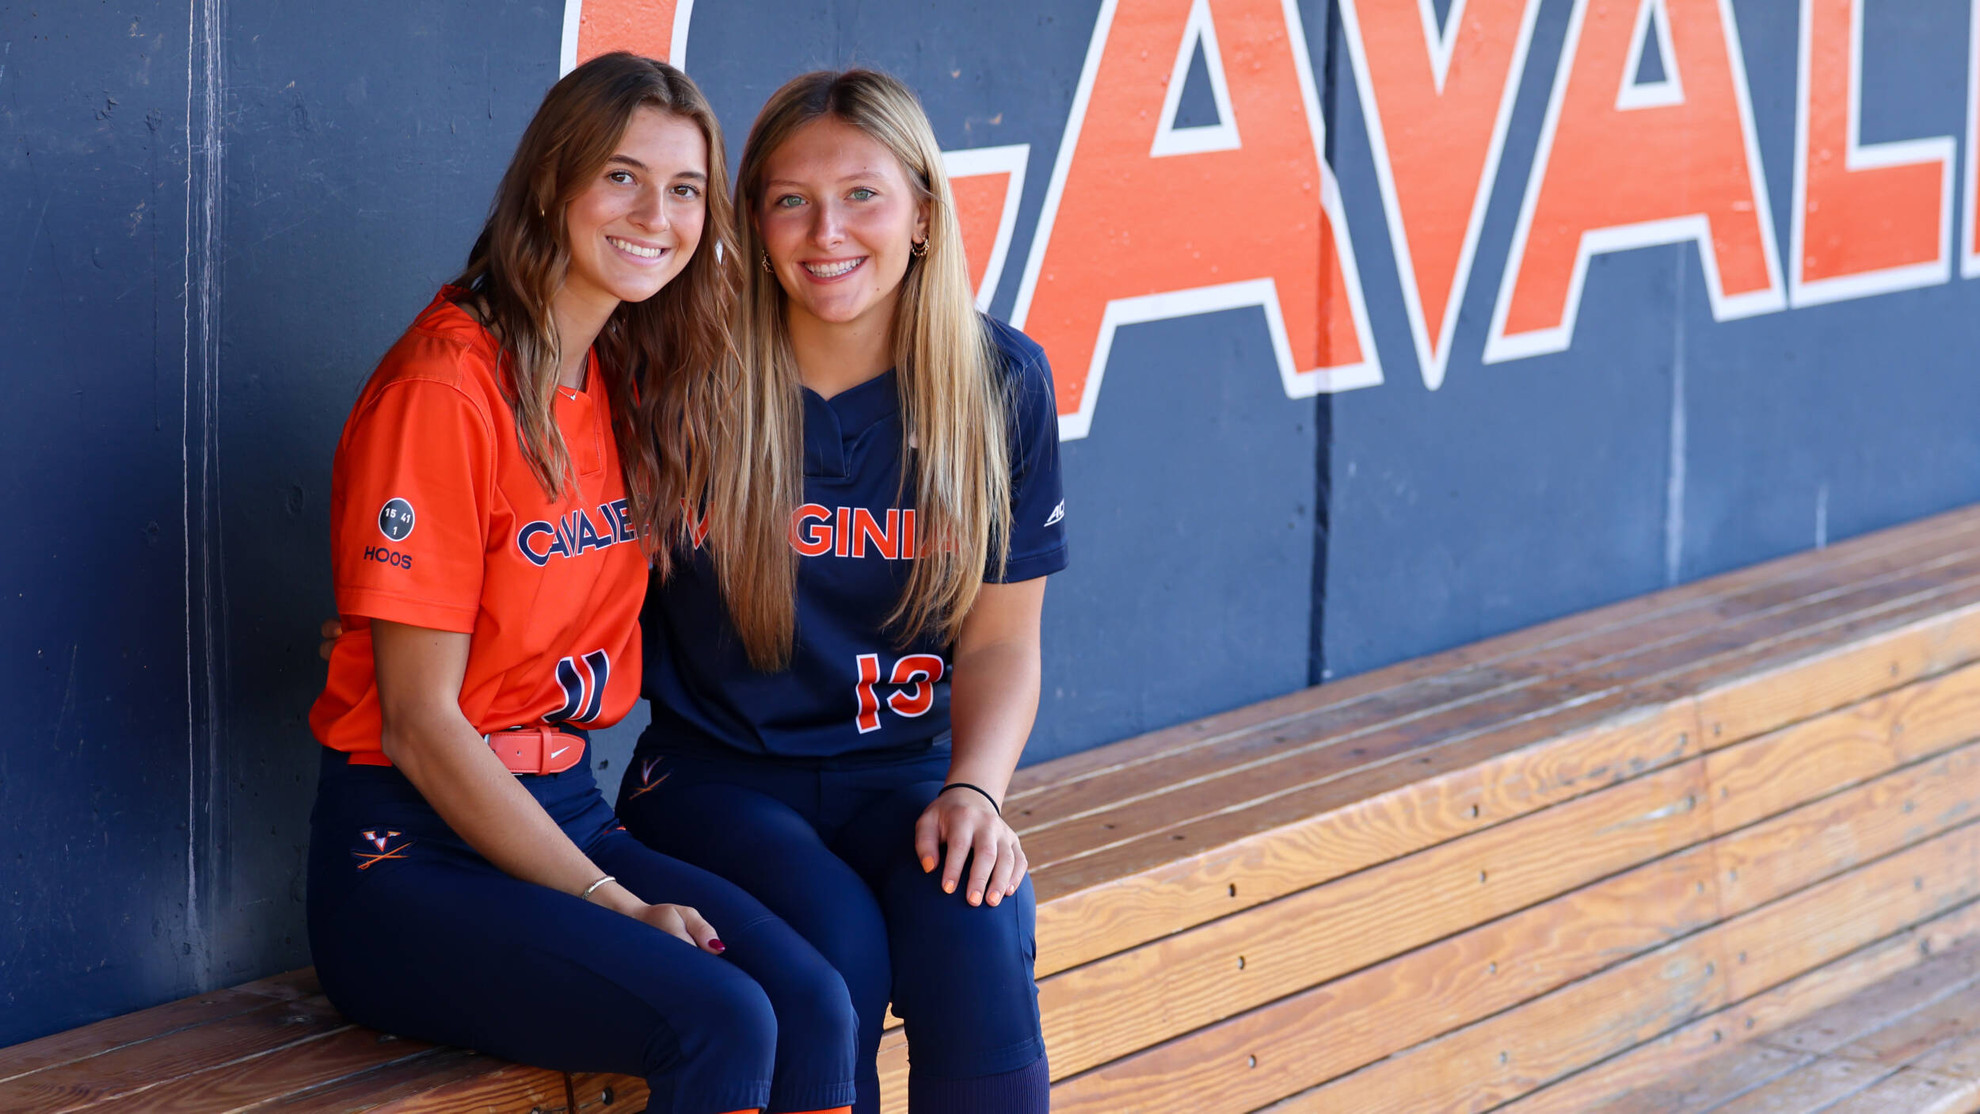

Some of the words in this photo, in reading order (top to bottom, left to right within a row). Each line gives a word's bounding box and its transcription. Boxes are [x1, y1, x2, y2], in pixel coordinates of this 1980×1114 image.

[559, 0, 1980, 441] AVAL
[385, 507, 397, 519] 15
[400, 512, 411, 524] 41
[393, 526, 398, 536] 1
[517, 498, 649, 567] CAVALIE
[679, 497, 961, 560] VGINI
[363, 545, 413, 570] HOOS
[541, 648, 611, 724] 11
